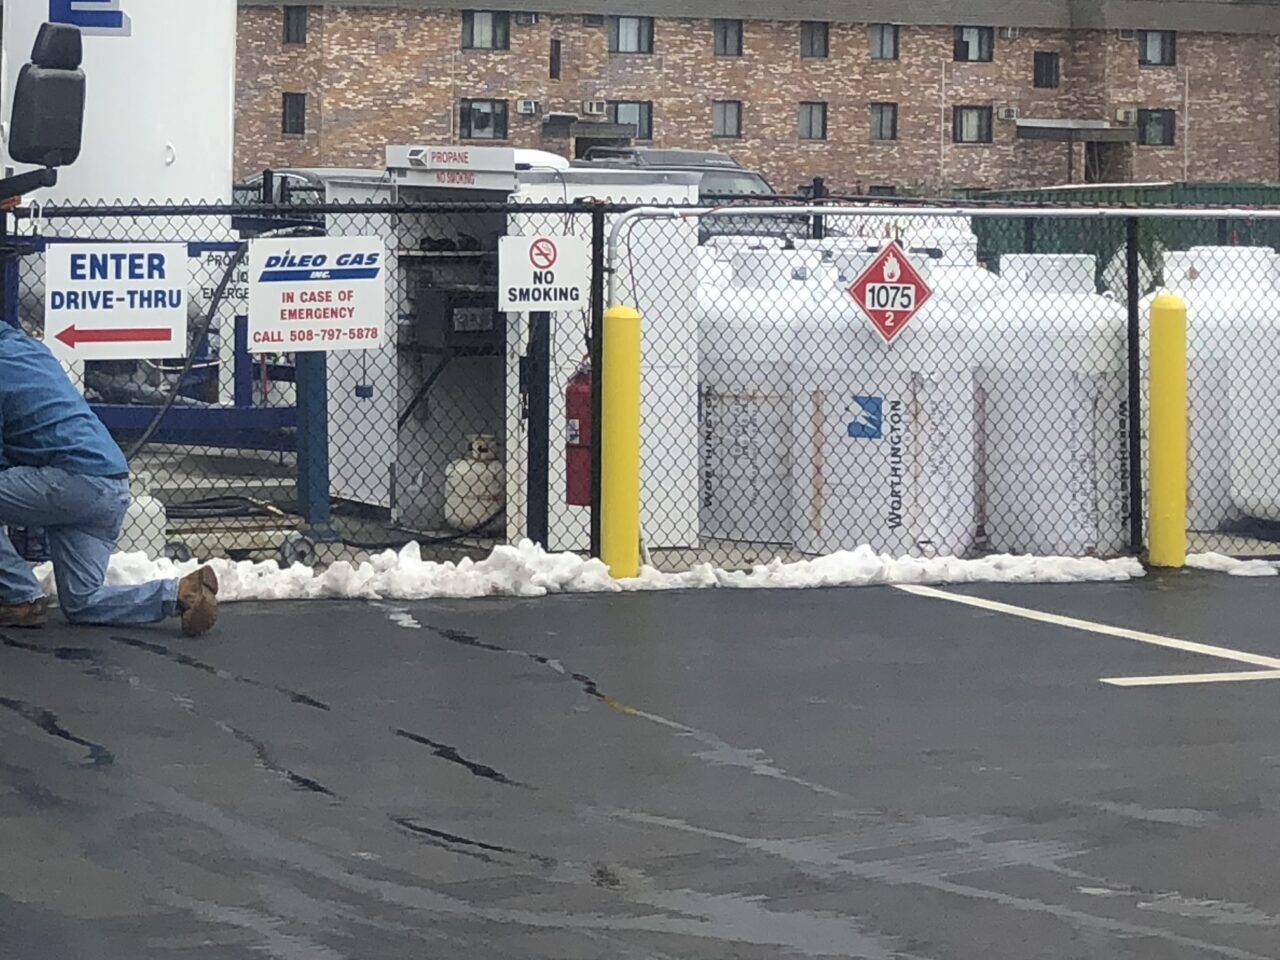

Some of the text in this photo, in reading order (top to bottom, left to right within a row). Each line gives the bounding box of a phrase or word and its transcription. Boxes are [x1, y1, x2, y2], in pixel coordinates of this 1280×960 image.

[431, 151, 469, 165] PROPANE
[436, 171, 476, 185] NO SMOKING
[70, 253, 166, 280] ENTER
[336, 252, 380, 266] GAS
[309, 271, 331, 279] INC.
[533, 271, 555, 285] NO
[51, 289, 182, 310] DRIVE-THRU
[282, 290, 354, 303] IN CASE OF
[508, 287, 580, 302] SMOKING
[868, 285, 912, 309] 1075
[280, 307, 355, 320] EMERGENCY
[884, 311, 895, 327] 2
[253, 327, 378, 343] CALL 508-797-5878
[704, 385, 713, 508] WORTHINGTON
[888, 400, 902, 529] WORTHINGTON
